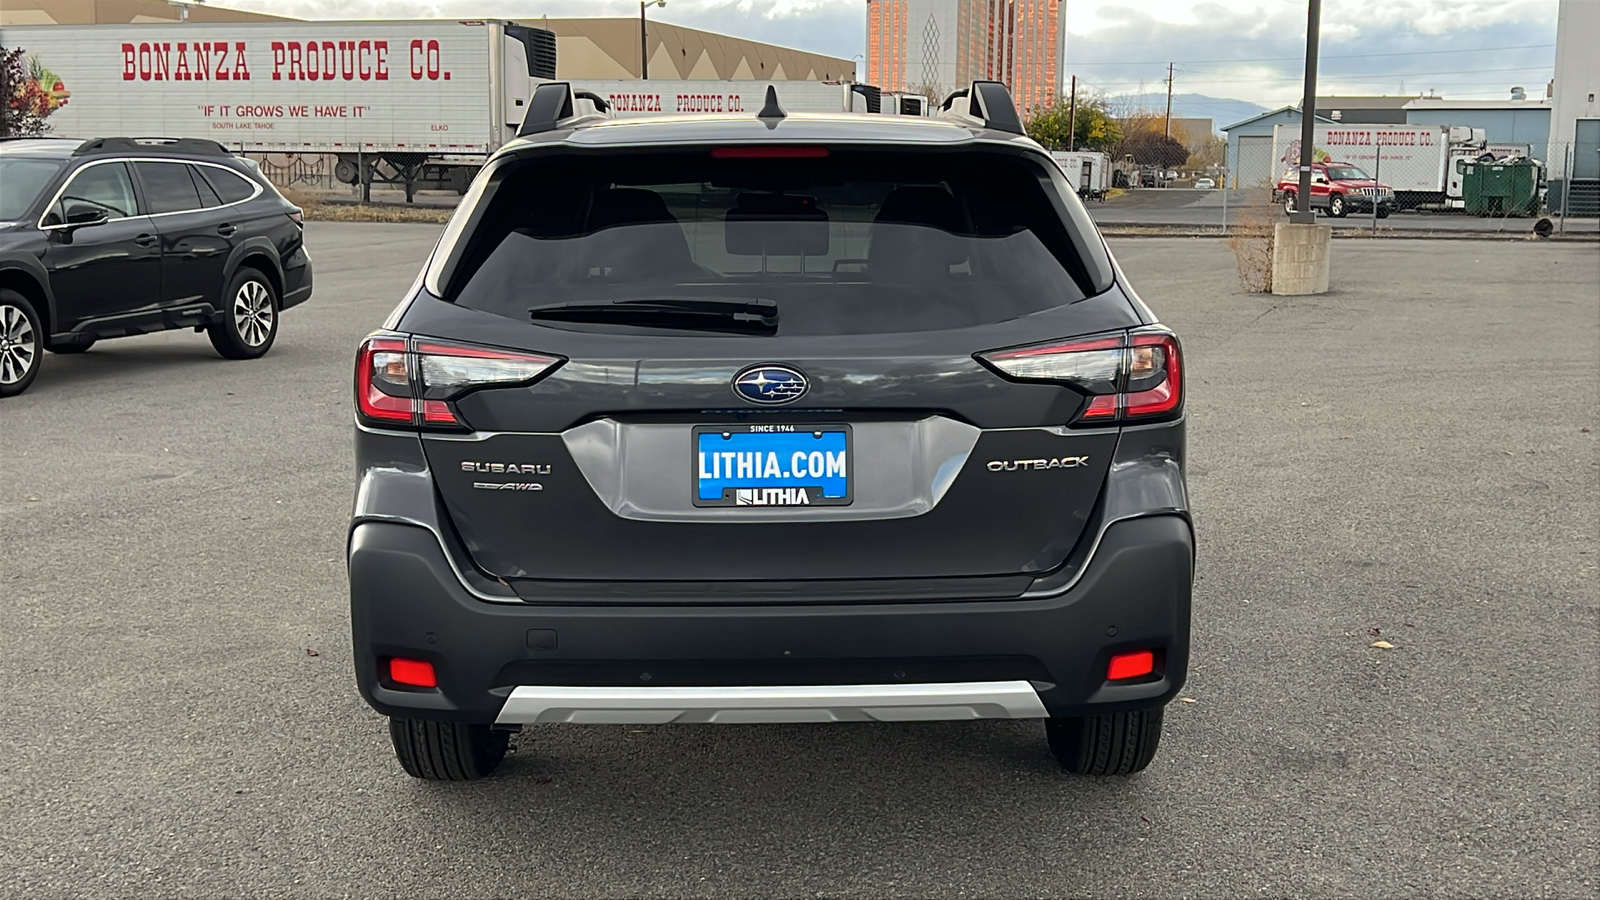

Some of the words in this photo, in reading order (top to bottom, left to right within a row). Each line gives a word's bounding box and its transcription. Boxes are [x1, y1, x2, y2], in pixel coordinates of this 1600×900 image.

[121, 42, 250, 81] BONANZA
[271, 40, 389, 81] PRODUCE
[410, 39, 451, 80] CO.
[676, 94, 722, 112] PRODUCE
[727, 94, 744, 112] CO.
[219, 105, 231, 117] IT
[235, 105, 284, 118] GROWS
[288, 105, 309, 118] WE
[314, 106, 347, 118] HAVE
[212, 122, 234, 130] SOUTH
[235, 122, 252, 130] LAKE
[254, 122, 275, 130] TAHOE
[431, 124, 449, 132] ELKO
[1327, 131, 1371, 146] BONANZA
[1376, 131, 1416, 146] PRODUCE
[1419, 132, 1434, 147] CO.
[461, 461, 552, 475] SUBARU
[699, 451, 846, 479] LITHIA.COM
[986, 455, 1089, 472] OUTBACK
[753, 488, 809, 505] LITHIA
